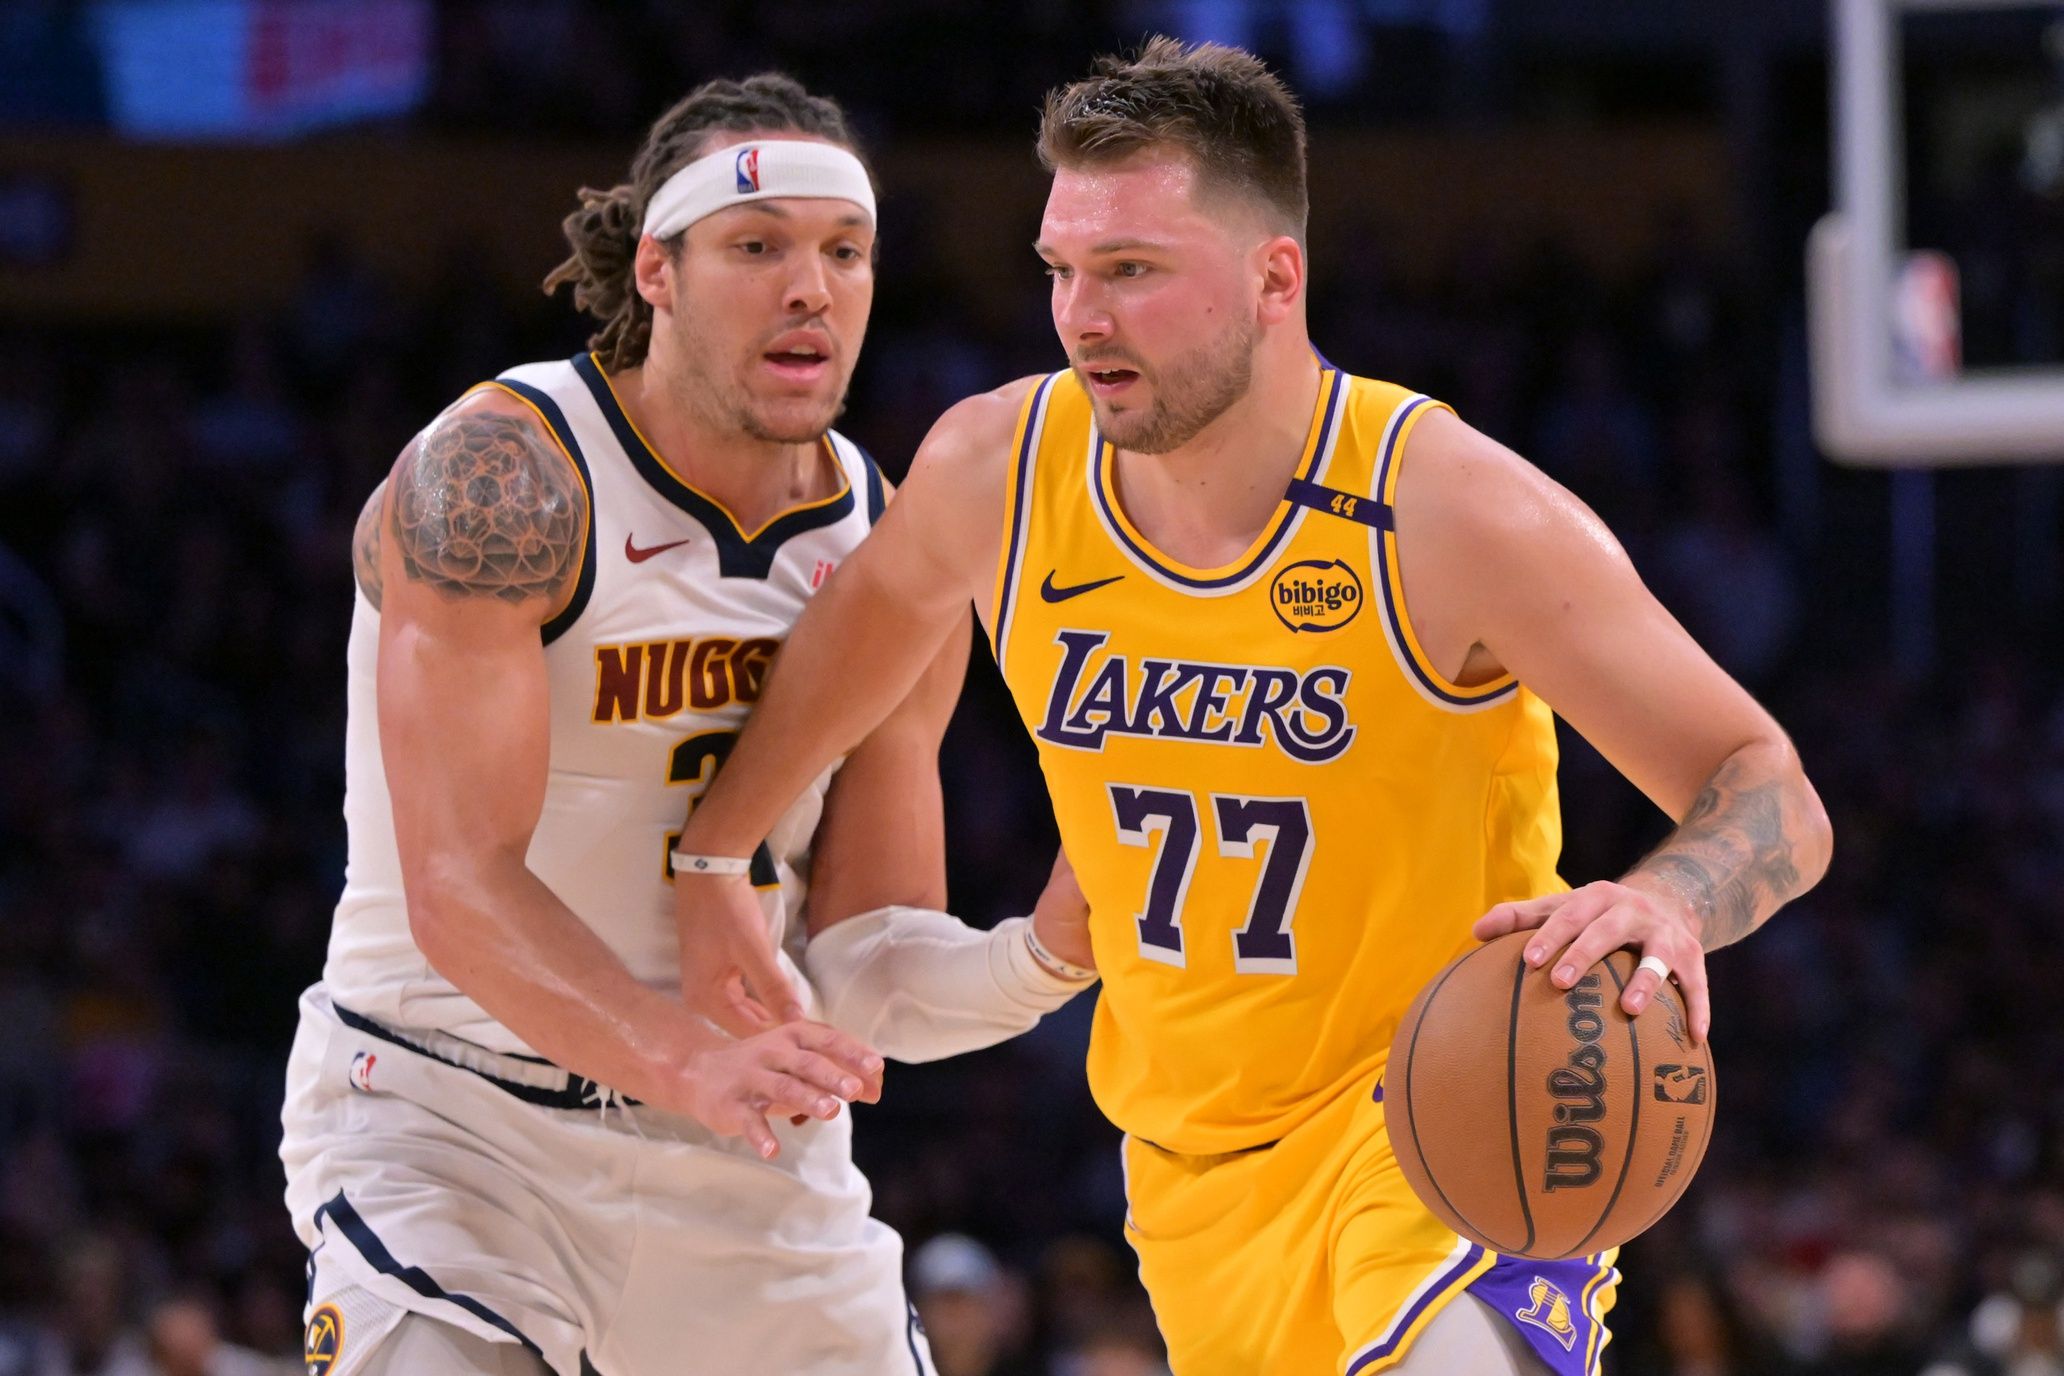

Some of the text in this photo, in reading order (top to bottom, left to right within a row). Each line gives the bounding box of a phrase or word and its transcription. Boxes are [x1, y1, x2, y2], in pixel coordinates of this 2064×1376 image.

[1330, 494, 1358, 517] 44
[1278, 579, 1357, 610] bibigo
[1293, 604, 1325, 617] 비비고
[591, 635, 784, 725] NUGG
[1034, 627, 1358, 765] LAKERS
[1104, 782, 1316, 975] 77
[1542, 973, 1608, 1194] Wilson
